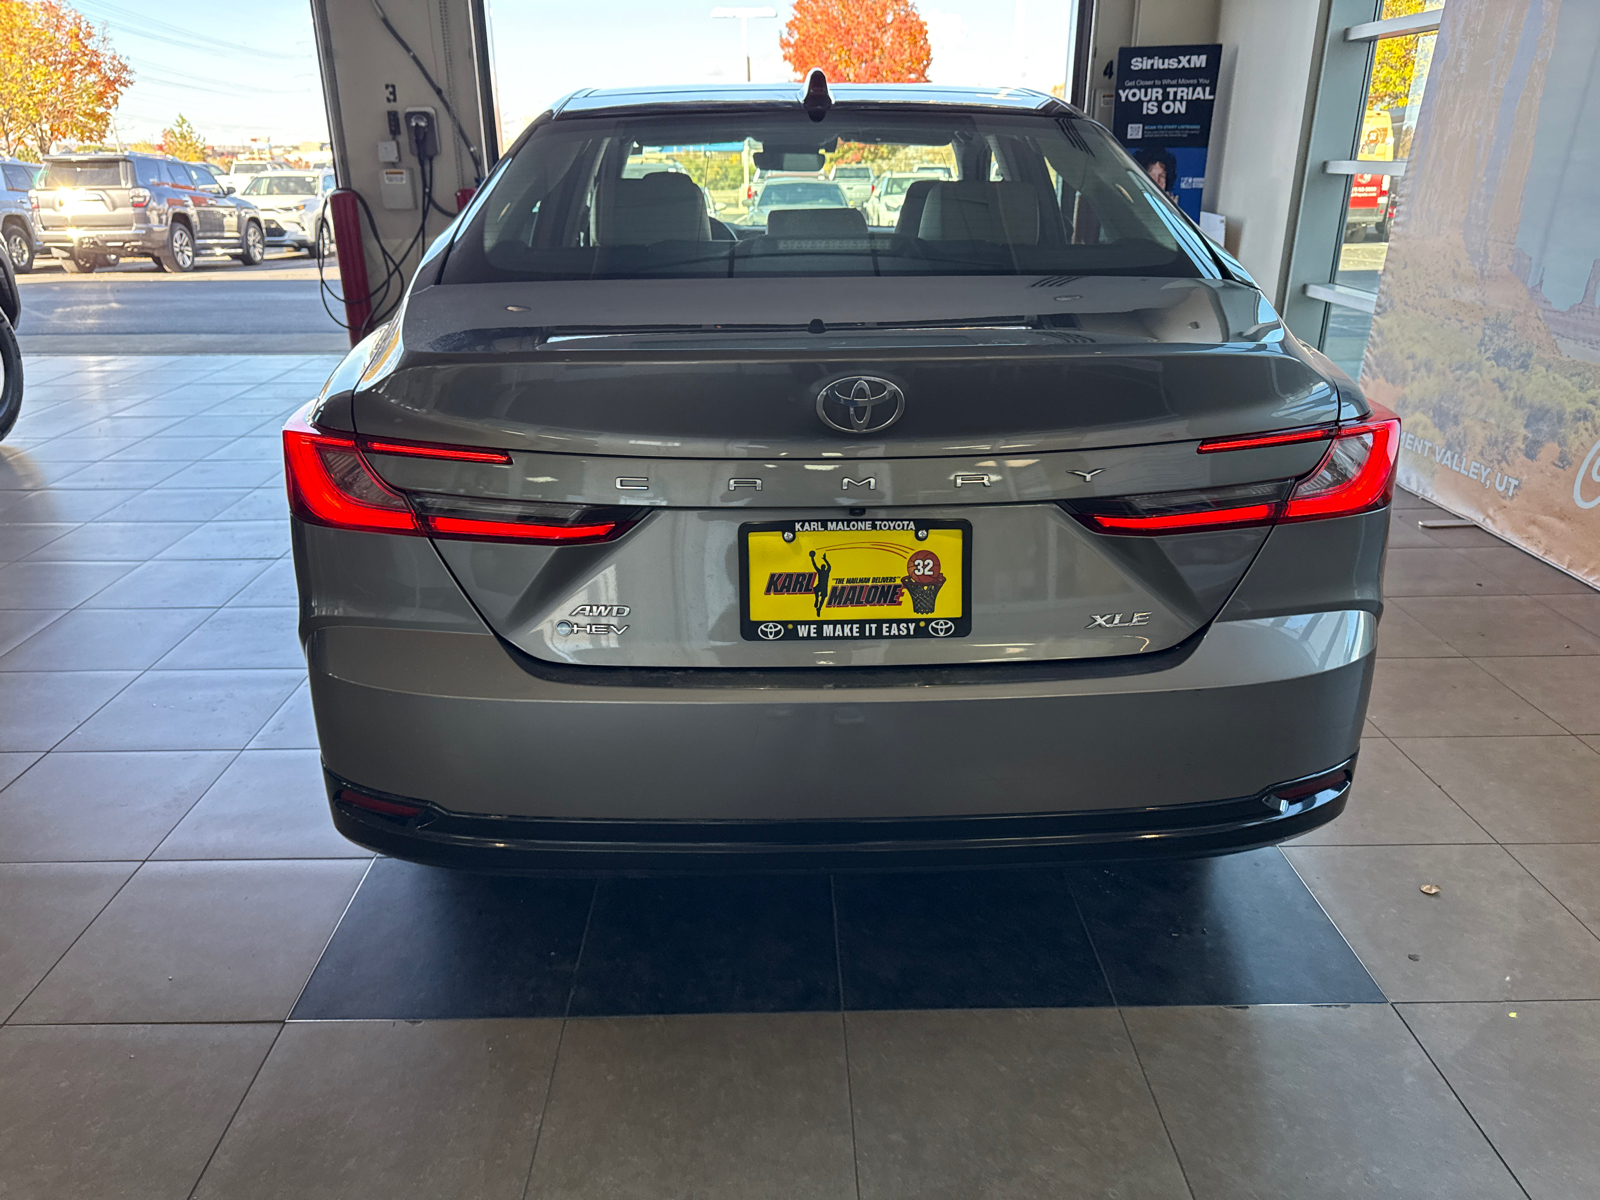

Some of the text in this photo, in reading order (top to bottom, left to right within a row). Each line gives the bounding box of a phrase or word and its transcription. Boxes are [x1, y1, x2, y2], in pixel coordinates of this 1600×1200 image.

[1130, 54, 1207, 70] SiriusXM
[385, 83, 397, 103] 3
[1118, 86, 1214, 102] YOUR TRIAL
[1142, 101, 1187, 115] IS ON
[1435, 445, 1491, 489] VALLEY,
[1494, 472, 1519, 497] UT
[615, 468, 1107, 492] CAMRY
[795, 521, 916, 531] KARL MALONE TOYOTA
[914, 559, 934, 576] 32
[764, 572, 817, 595] KARL
[826, 583, 904, 608] MALONE
[569, 604, 631, 617] AWD
[1084, 611, 1152, 629] XLE
[572, 623, 631, 635] HEV
[797, 623, 916, 637] WE MAKE IT EASY
